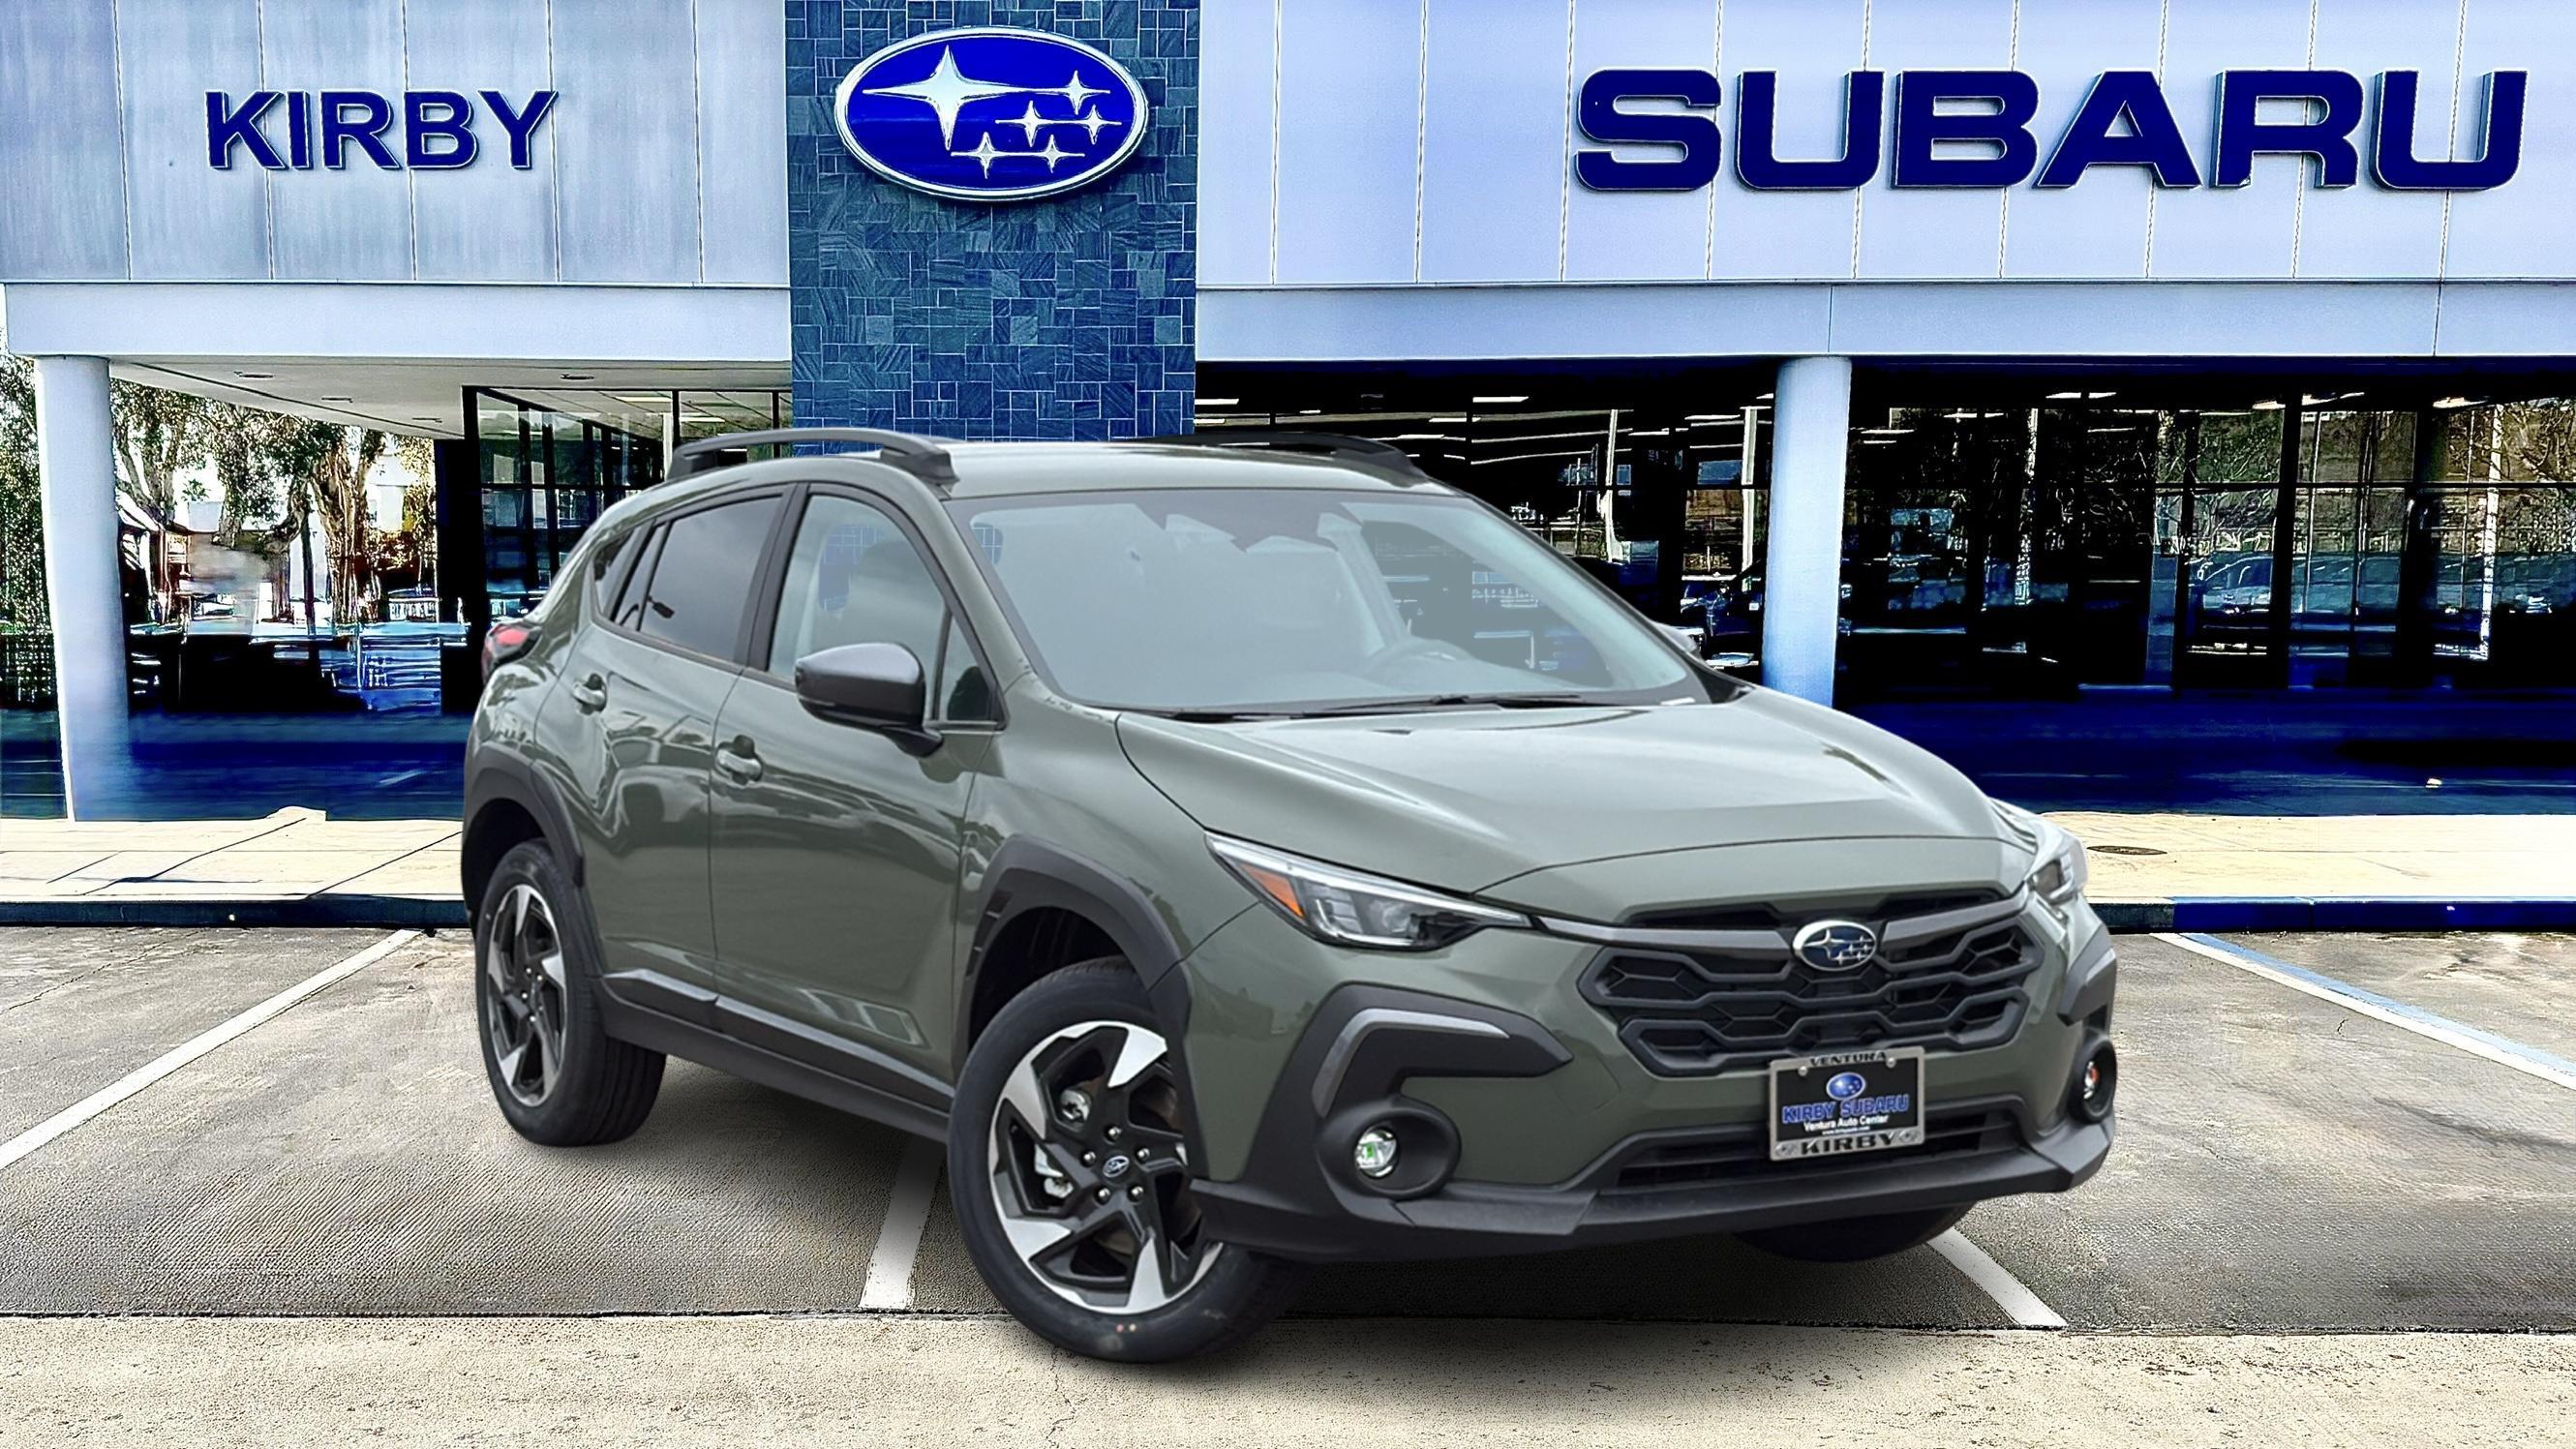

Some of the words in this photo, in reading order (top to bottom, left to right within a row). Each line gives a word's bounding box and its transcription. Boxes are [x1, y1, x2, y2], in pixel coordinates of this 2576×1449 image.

[205, 90, 560, 170] KIRBY
[1575, 68, 2528, 191] SUBARU
[1810, 1051, 1886, 1066] VENTURA
[1782, 1102, 1836, 1123] KIRBY
[1840, 1094, 1909, 1117] SUBARU
[1803, 1119, 1836, 1132] Ventura
[1837, 1116, 1858, 1128] Auto
[1860, 1114, 1889, 1126] Center
[1801, 1131, 1894, 1155] KIRBY
